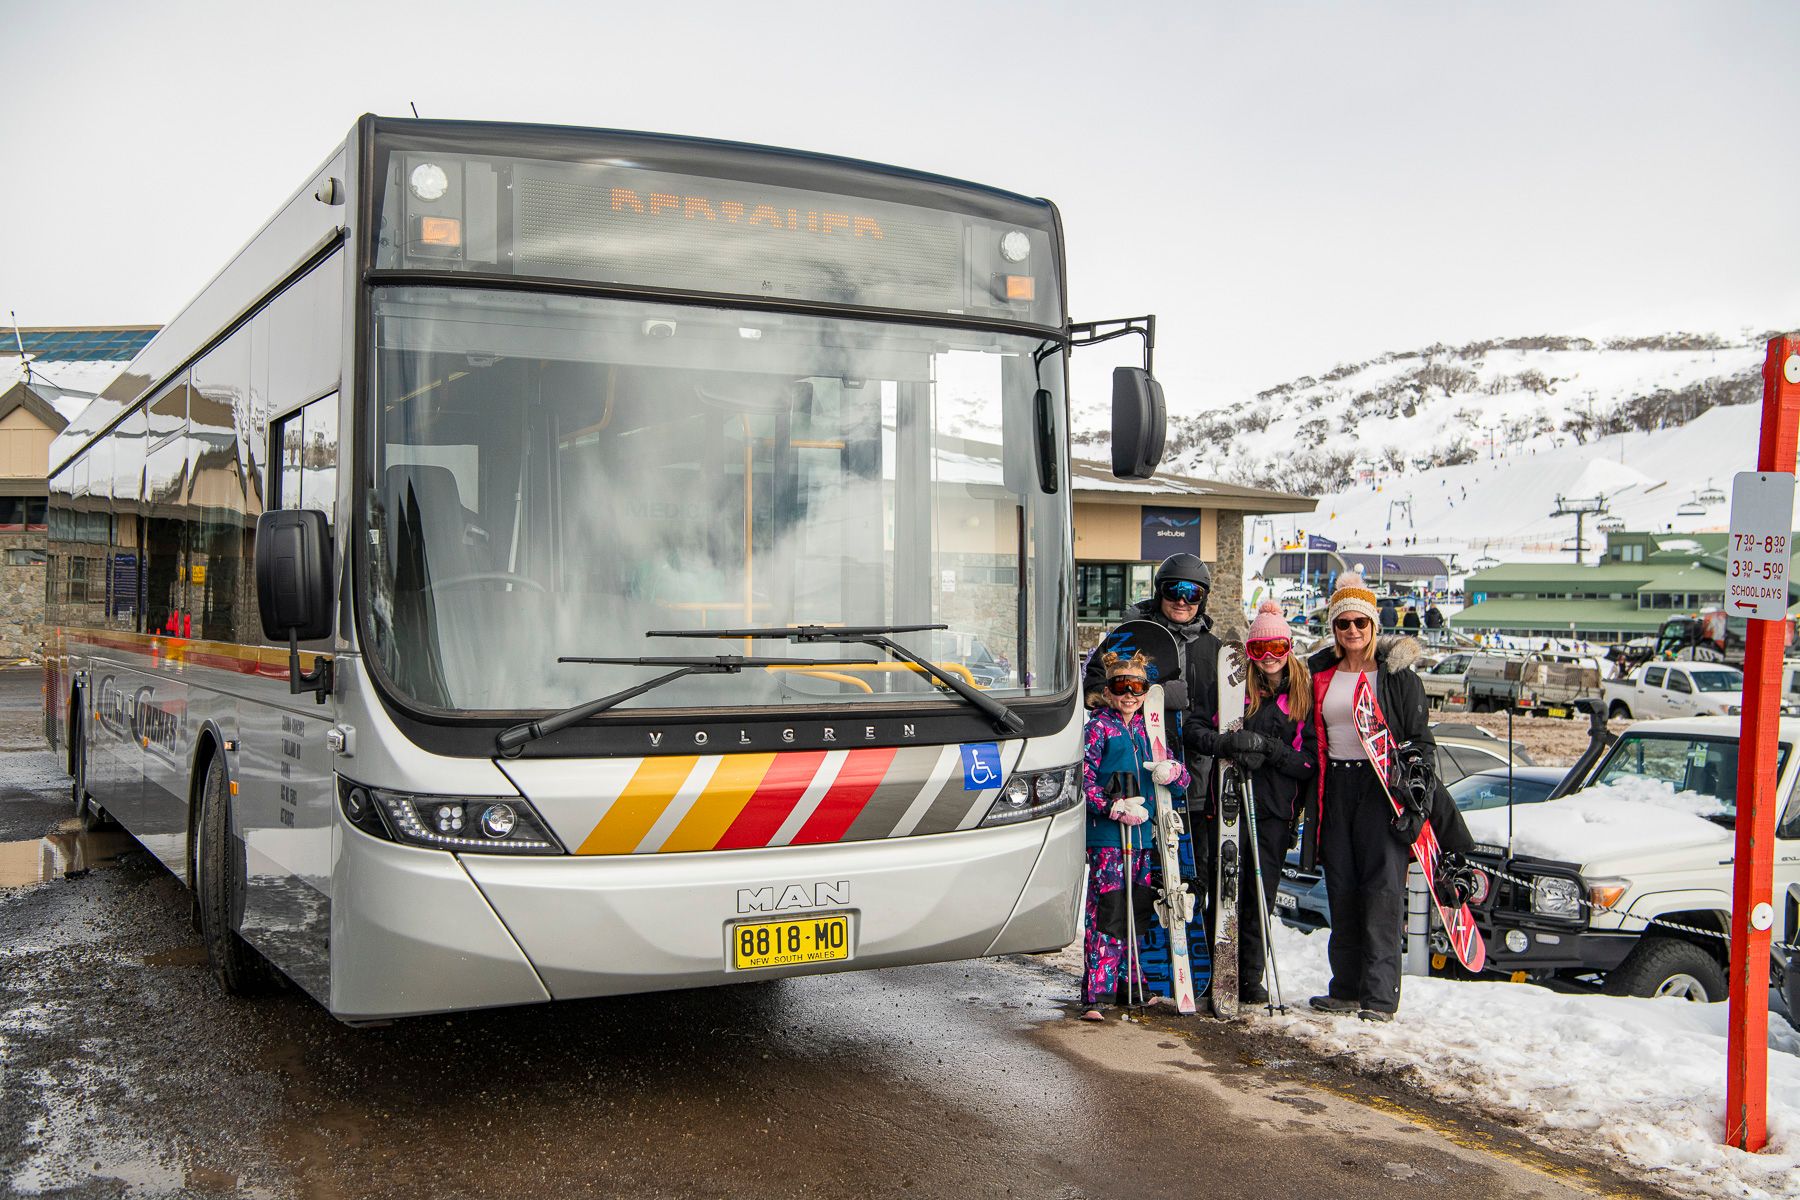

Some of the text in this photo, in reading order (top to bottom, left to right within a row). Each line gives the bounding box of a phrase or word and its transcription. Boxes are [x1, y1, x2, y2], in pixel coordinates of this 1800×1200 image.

[1731, 585, 1782, 600] SCHOOL DAYS
[649, 724, 915, 746] VOLGREN
[737, 880, 851, 914] MAN
[750, 950, 835, 966] NEW SOUTH WALES
